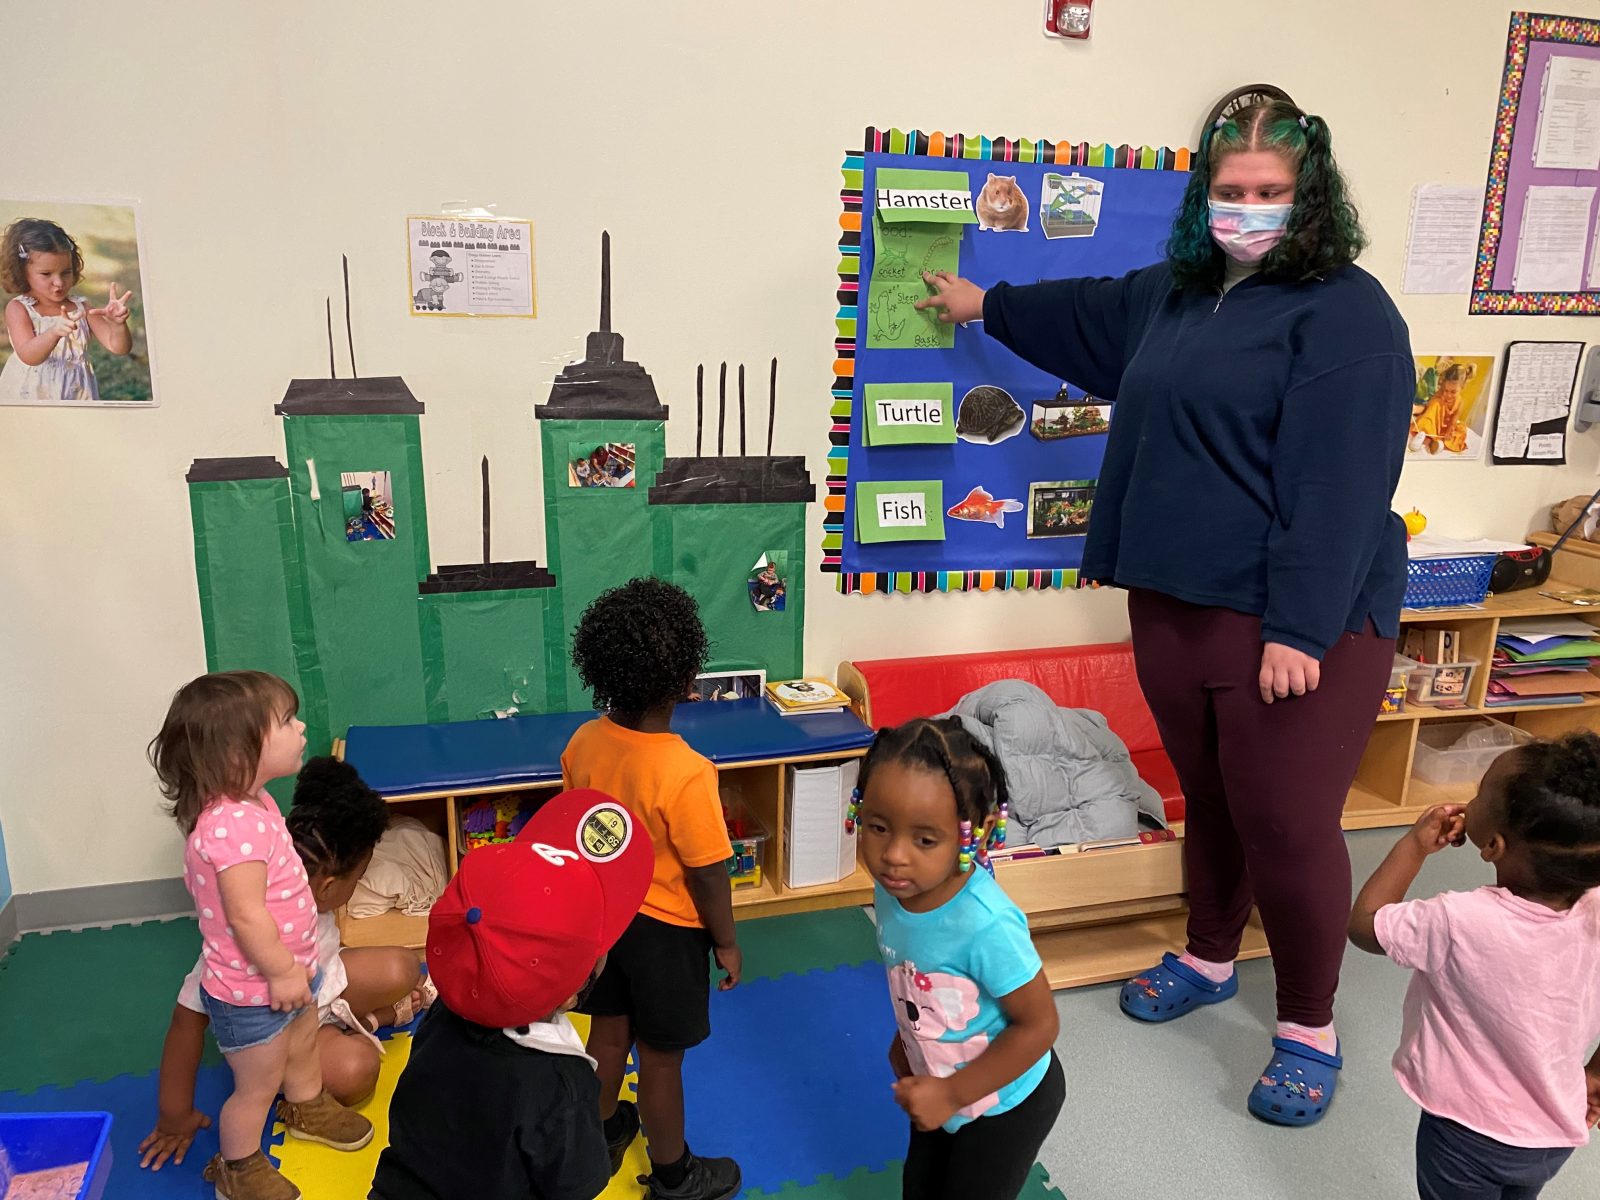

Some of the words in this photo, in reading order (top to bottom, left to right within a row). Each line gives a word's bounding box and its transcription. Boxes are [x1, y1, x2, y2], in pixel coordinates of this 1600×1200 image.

[876, 189, 972, 210] Hamster
[421, 221, 447, 238] Block
[458, 222, 494, 242] Building
[496, 224, 520, 241] Area
[878, 266, 905, 275] cricket
[897, 292, 919, 302] Sleep
[914, 334, 938, 345] Bask
[879, 402, 941, 423] Turtle
[882, 500, 922, 520] Fish
